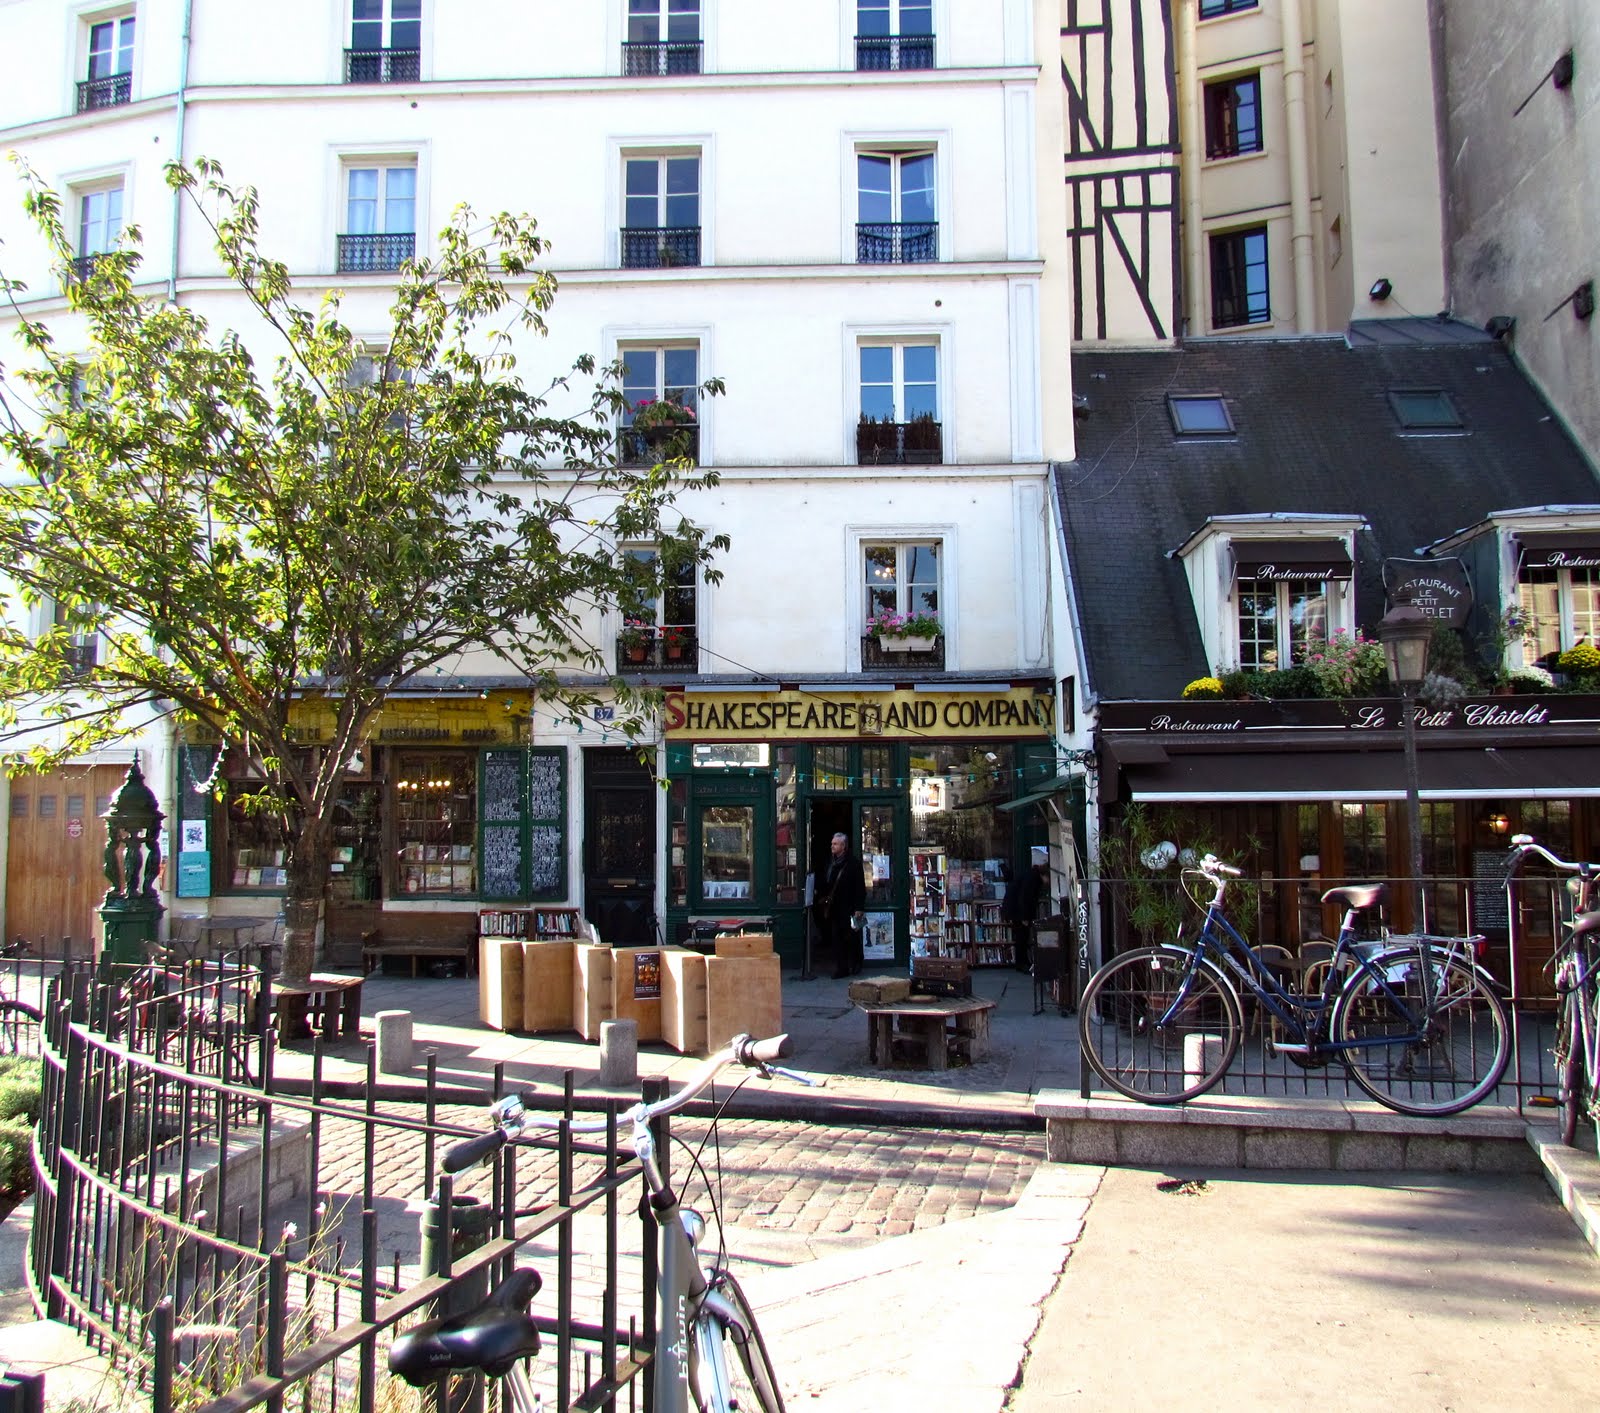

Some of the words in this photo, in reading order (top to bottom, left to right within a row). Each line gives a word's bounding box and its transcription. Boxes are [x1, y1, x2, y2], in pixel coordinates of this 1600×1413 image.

[1257, 565, 1333, 579] Restaurant
[1411, 598, 1439, 606] PETIT
[597, 709, 611, 720] 37
[665, 694, 856, 731] SHAKESPEARE
[885, 701, 937, 728] AND
[944, 700, 1055, 728] COMPANY
[1150, 715, 1241, 730] Restaurant
[1351, 706, 1385, 728] Le
[1464, 704, 1548, 725] Châtelet
